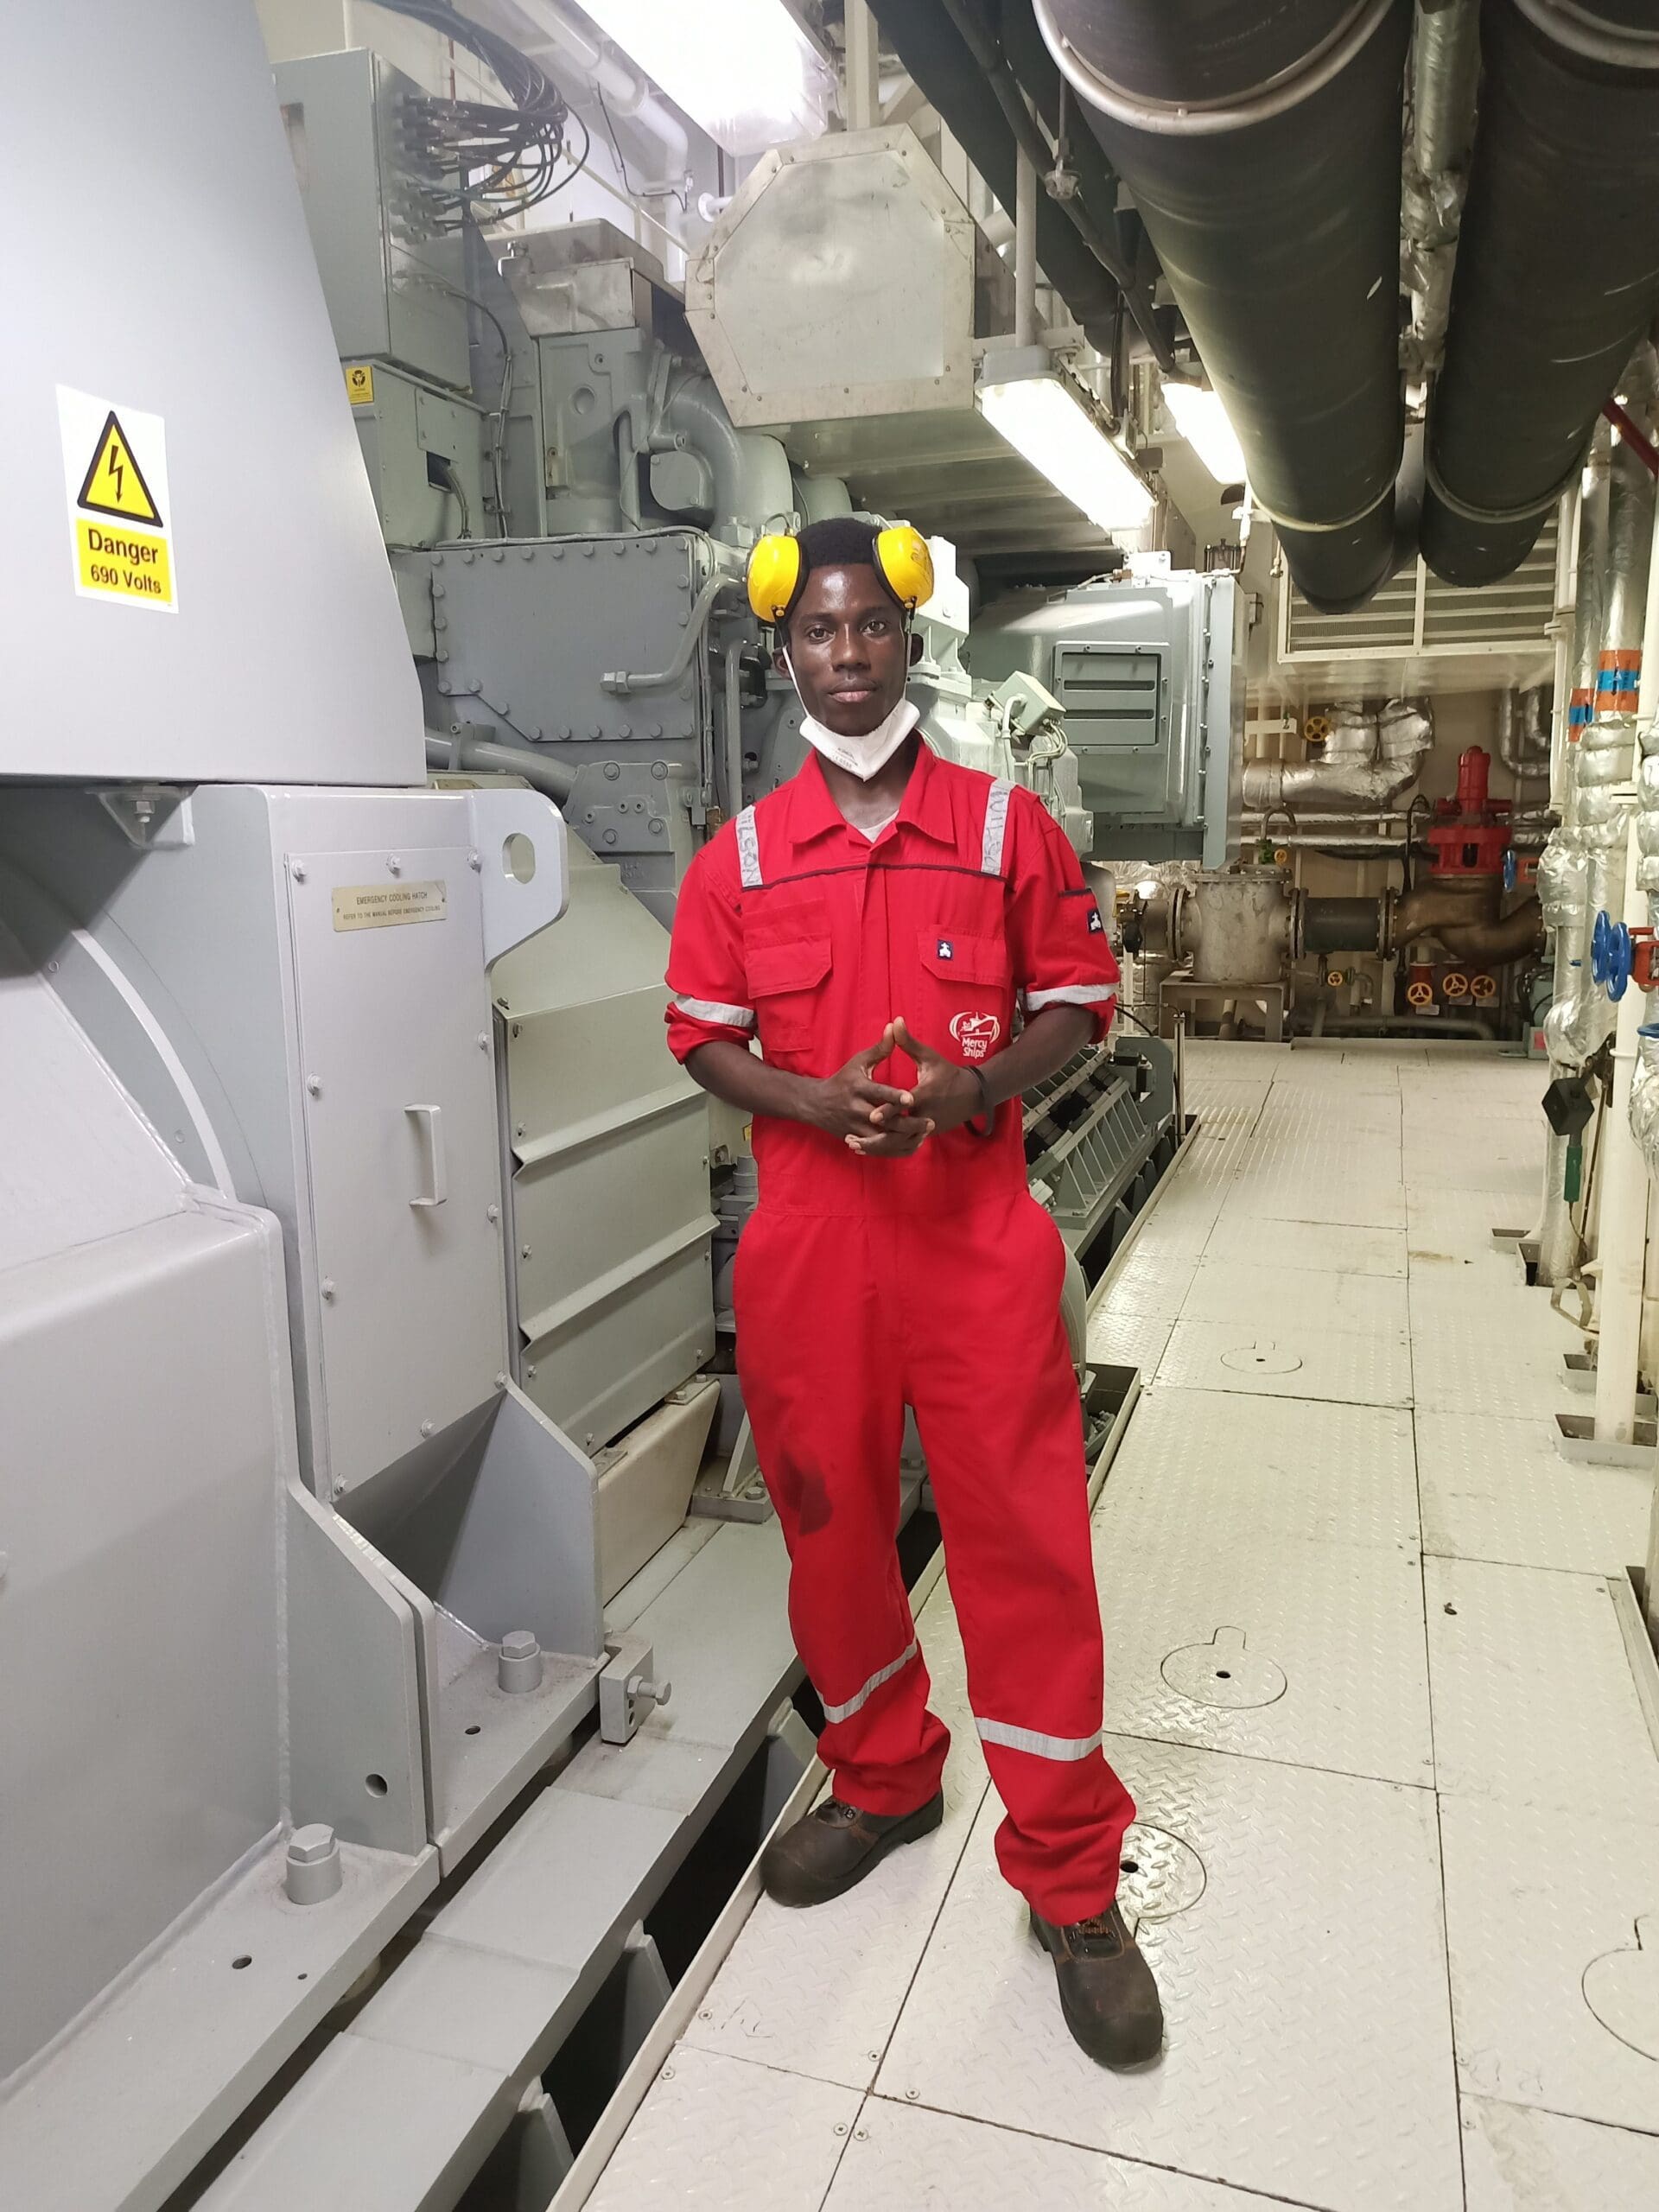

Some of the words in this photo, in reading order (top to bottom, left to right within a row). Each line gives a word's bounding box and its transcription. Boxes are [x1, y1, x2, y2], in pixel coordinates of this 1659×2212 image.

[88, 528, 158, 565] Danger
[91, 564, 118, 586] 690
[123, 569, 162, 594] Volts
[356, 894, 387, 906] EMERGENCY
[388, 893, 411, 902] COOLING
[411, 891, 428, 900] HATCH
[962, 1037, 988, 1052] Mercy
[963, 1046, 984, 1059] Ships
